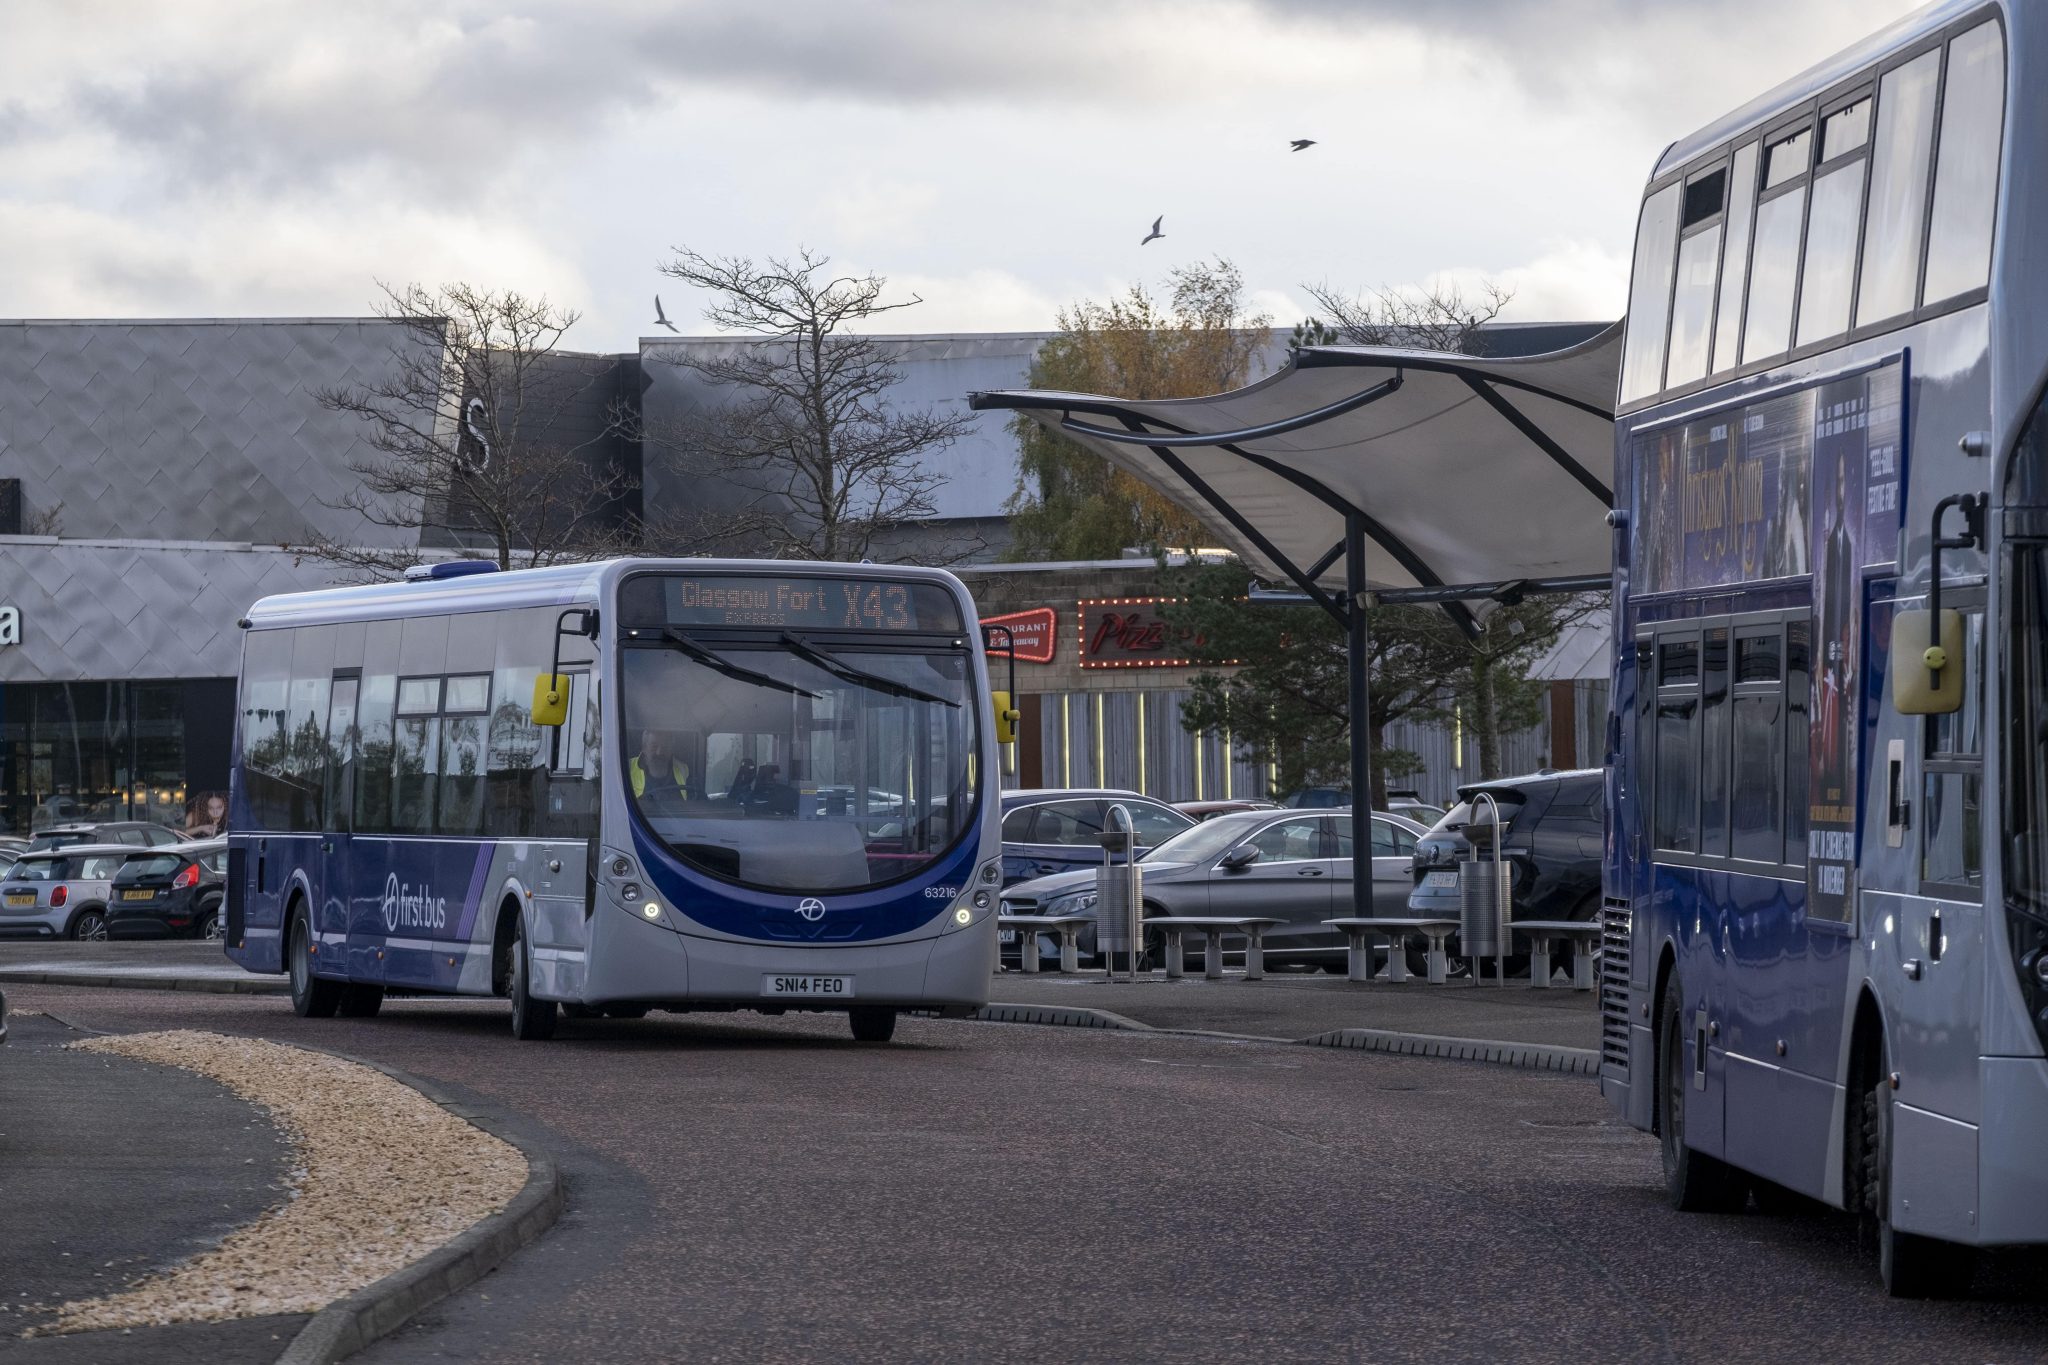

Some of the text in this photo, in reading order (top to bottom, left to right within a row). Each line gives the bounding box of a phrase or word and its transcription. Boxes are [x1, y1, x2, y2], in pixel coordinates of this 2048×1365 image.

[682, 581, 909, 629] Glasgow Fort X43
[1091, 612, 1167, 654] Pizz
[998, 637, 1039, 647] Taeaway
[924, 887, 957, 899] 63216
[775, 978, 808, 992] SN14
